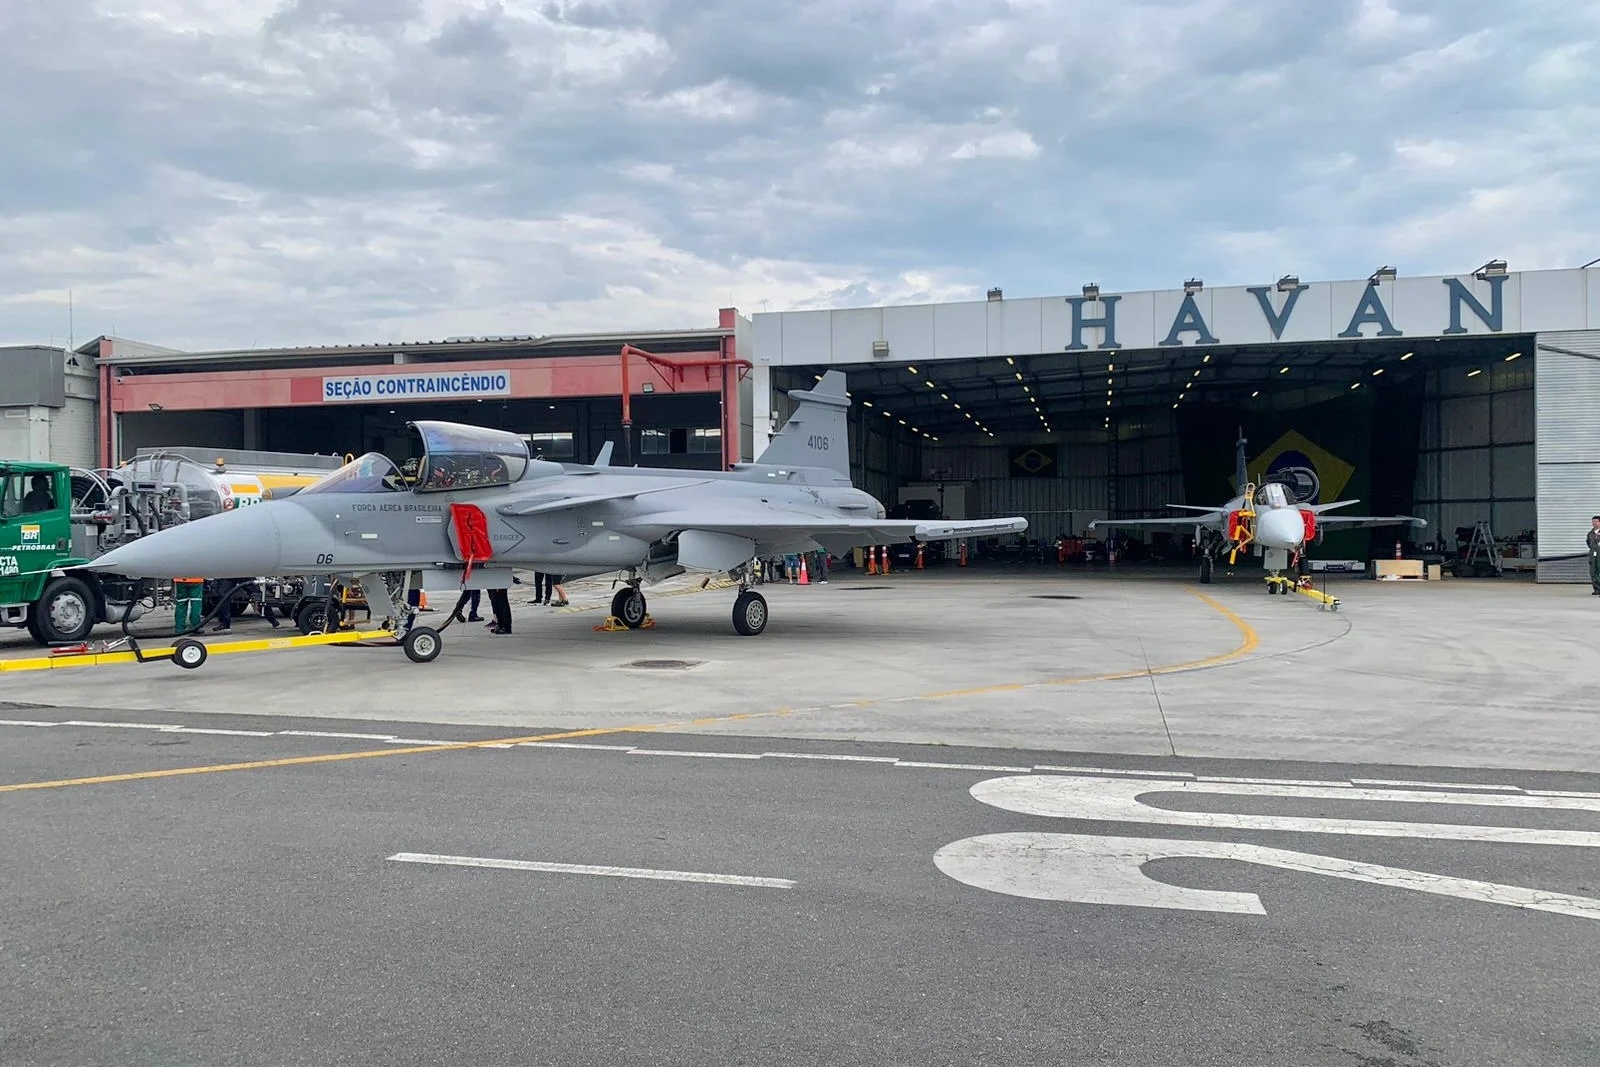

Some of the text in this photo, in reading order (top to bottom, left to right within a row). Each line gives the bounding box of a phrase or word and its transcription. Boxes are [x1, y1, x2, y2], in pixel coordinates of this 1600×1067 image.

[1065, 275, 1510, 351] HAVAN
[326, 374, 506, 399] SEÇÃO CONTRAINCÊNDIO
[808, 435, 829, 450] 4106
[404, 504, 442, 512] BRASILEIRA
[23, 531, 38, 540] BR
[316, 553, 334, 564] 06
